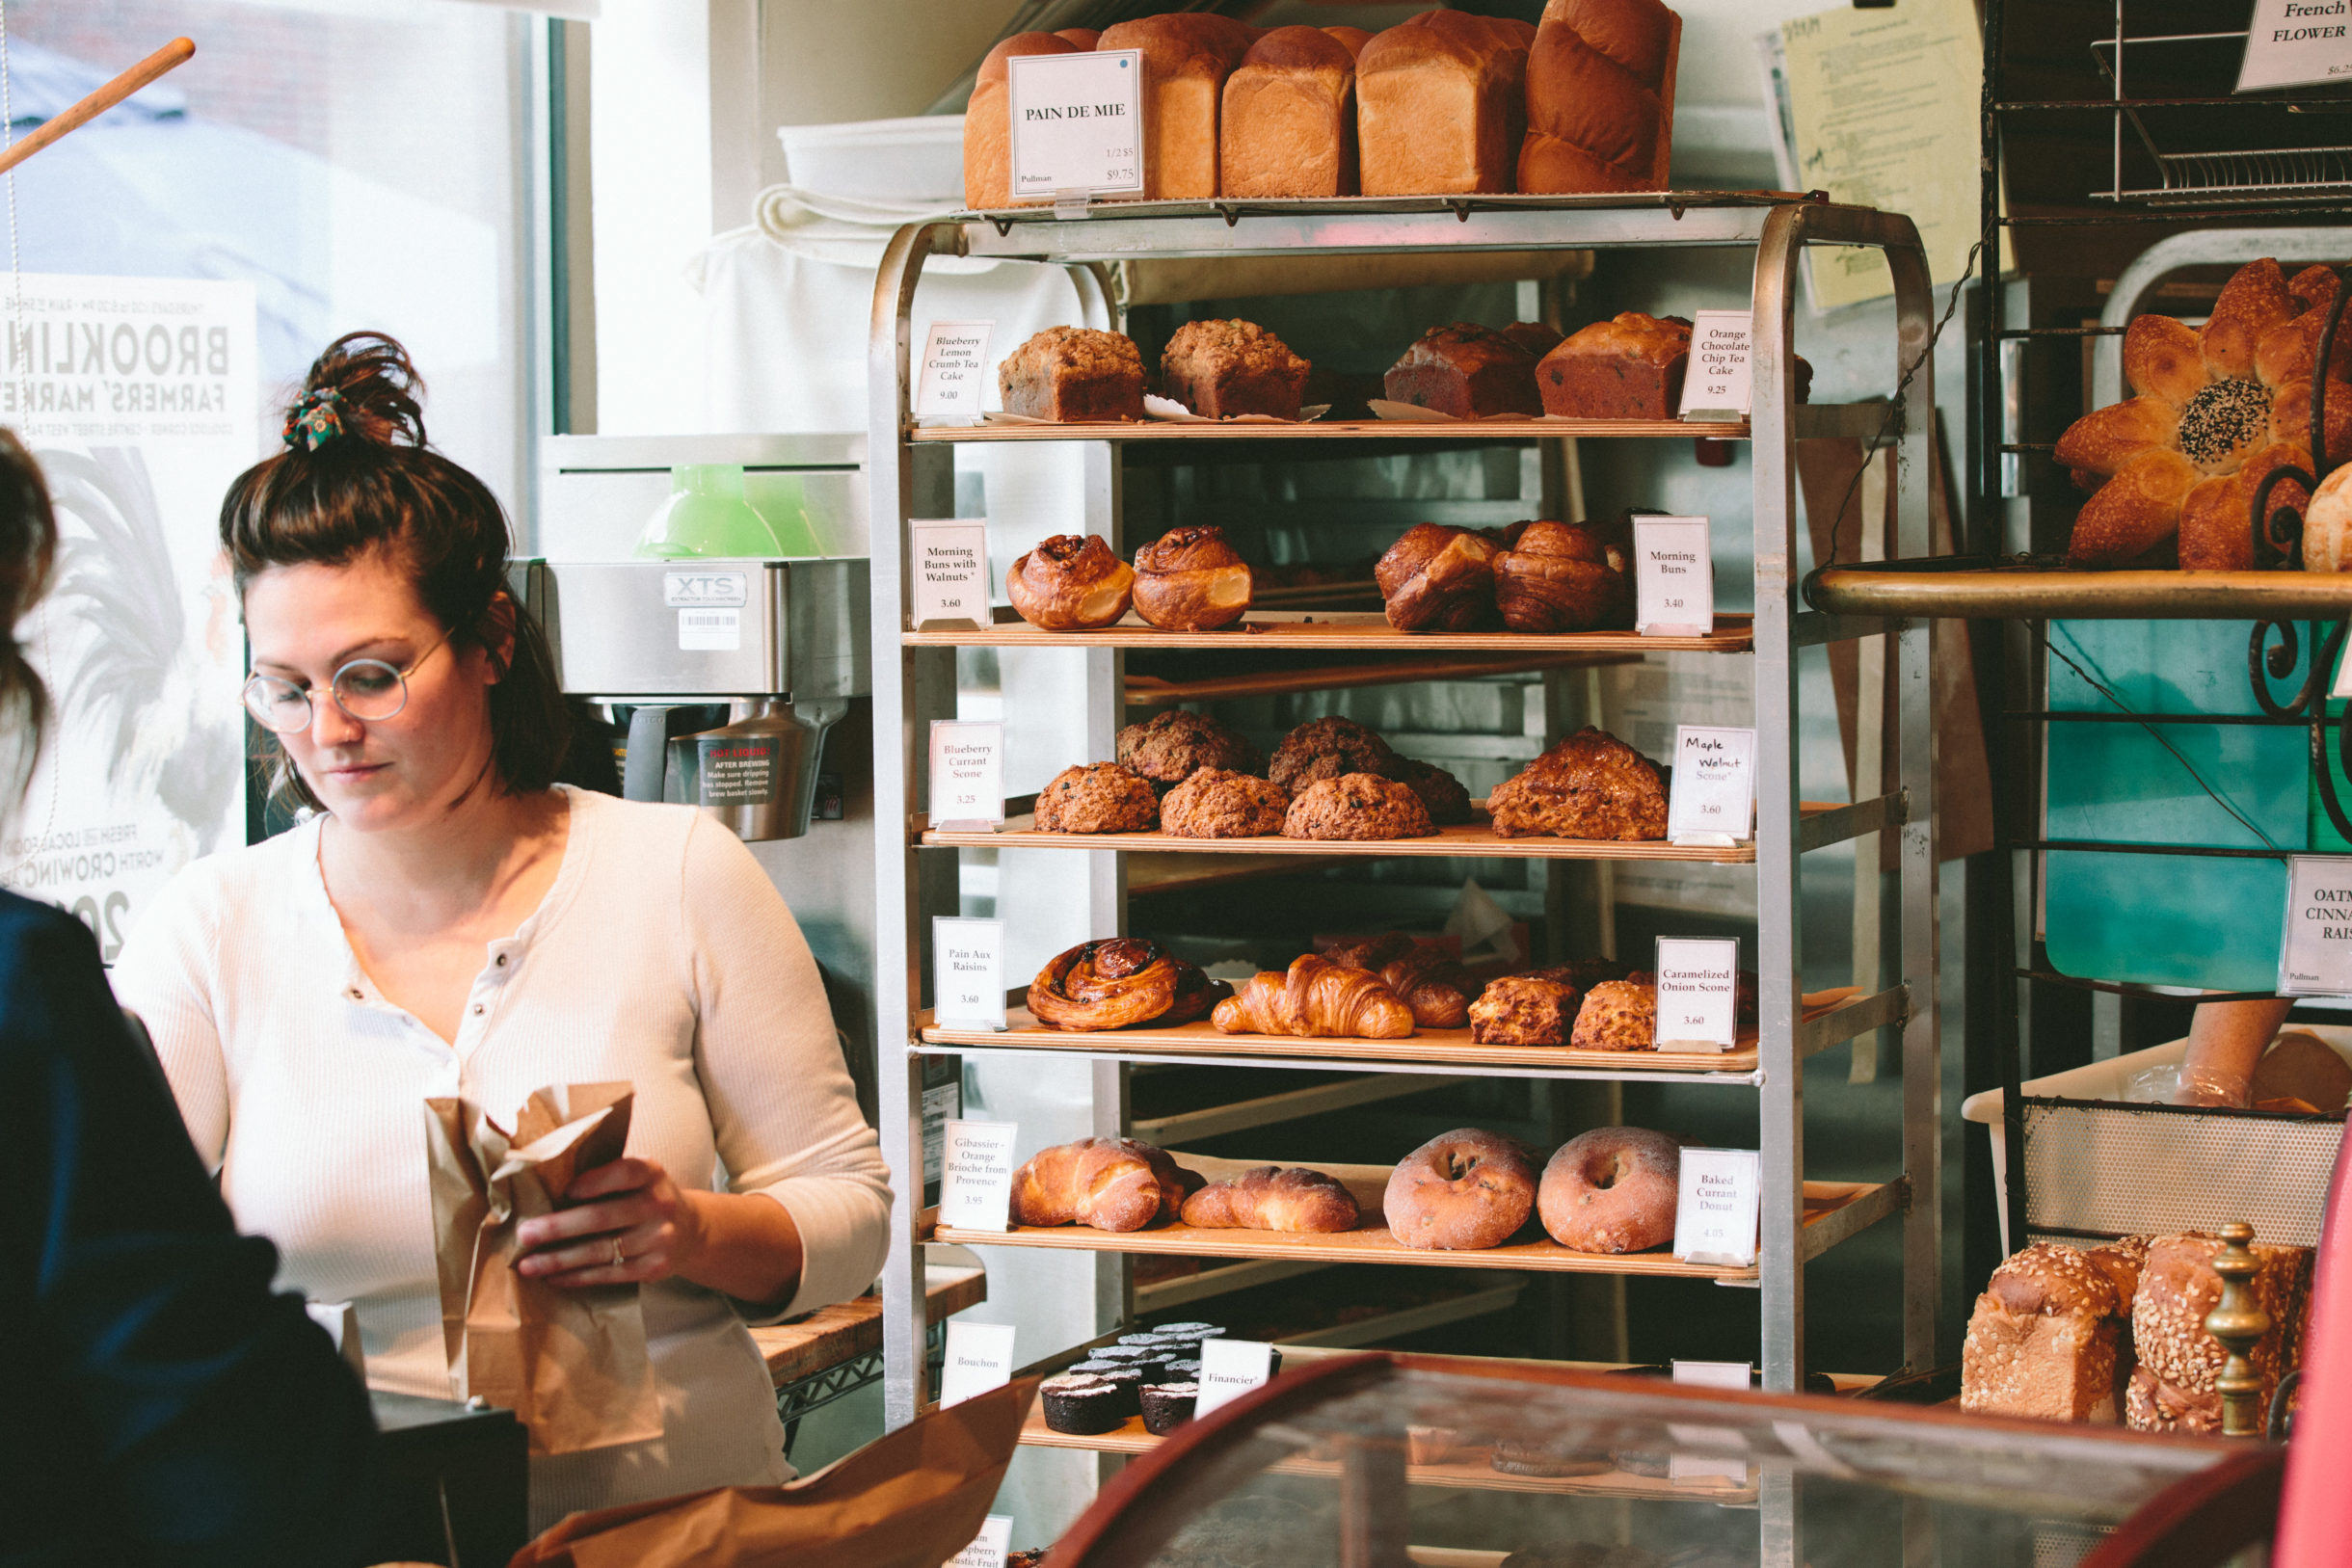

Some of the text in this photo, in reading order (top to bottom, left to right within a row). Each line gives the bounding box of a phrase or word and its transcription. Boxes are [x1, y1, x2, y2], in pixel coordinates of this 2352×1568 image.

[2284, 0, 2345, 17] French
[2272, 25, 2346, 42] FLOWER
[1026, 103, 1126, 120] PAIN DE MIE
[1107, 147, 1134, 158] 1/2 $5
[1021, 174, 1053, 183] Pullman
[1107, 169, 1135, 180] $9.75
[1709, 329, 1747, 340] Orange
[936, 336, 981, 347] Blueberry
[1701, 341, 1751, 351] Chocolate
[928, 359, 978, 368] Crumb Tea
[1701, 354, 1745, 364] Chip Tea
[1708, 365, 1733, 375] Cake
[940, 371, 964, 381] Cake
[1707, 385, 1726, 394] 9.25
[940, 390, 958, 400] 9.00
[927, 547, 973, 557] Morning
[1650, 551, 1696, 563] Morning
[924, 560, 976, 569] Buns with
[1661, 564, 1687, 573] Buns
[926, 572, 968, 582] Walnuts
[678, 577, 735, 595] XTS
[941, 598, 961, 608] 3.60
[1664, 598, 1684, 608] 3.40
[1685, 737, 1724, 752] Maple
[709, 747, 771, 758] HOT LIQUID!
[944, 745, 992, 755] Blueberry
[738, 759, 770, 768] BREWING
[949, 757, 987, 766] Currant
[742, 770, 769, 779] dripping
[952, 769, 982, 779] Scone
[956, 795, 976, 804] 3.25
[1700, 805, 1722, 814] 3.60
[949, 949, 991, 959] Pain Aux
[953, 962, 988, 971] Raisins
[1663, 969, 1729, 979] Caramelized
[2289, 972, 2319, 981] Pullman
[1662, 982, 1730, 992] Onion Scone
[961, 995, 979, 1003] 3.60
[1683, 1016, 1704, 1025] 3.60
[954, 1138, 999, 1149] Gibassier
[961, 1151, 996, 1163] Orange
[948, 1162, 1007, 1174] Brioche from
[955, 1176, 998, 1186] Provence
[1701, 1175, 1734, 1185] Baked
[1697, 1187, 1737, 1199] Currant
[964, 1195, 983, 1205] 3.95
[1699, 1201, 1733, 1211] Donut
[957, 1356, 999, 1369] Bouchon
[964, 1546, 998, 1556] spberry
[949, 1556, 999, 1568] Rustic Fruit
